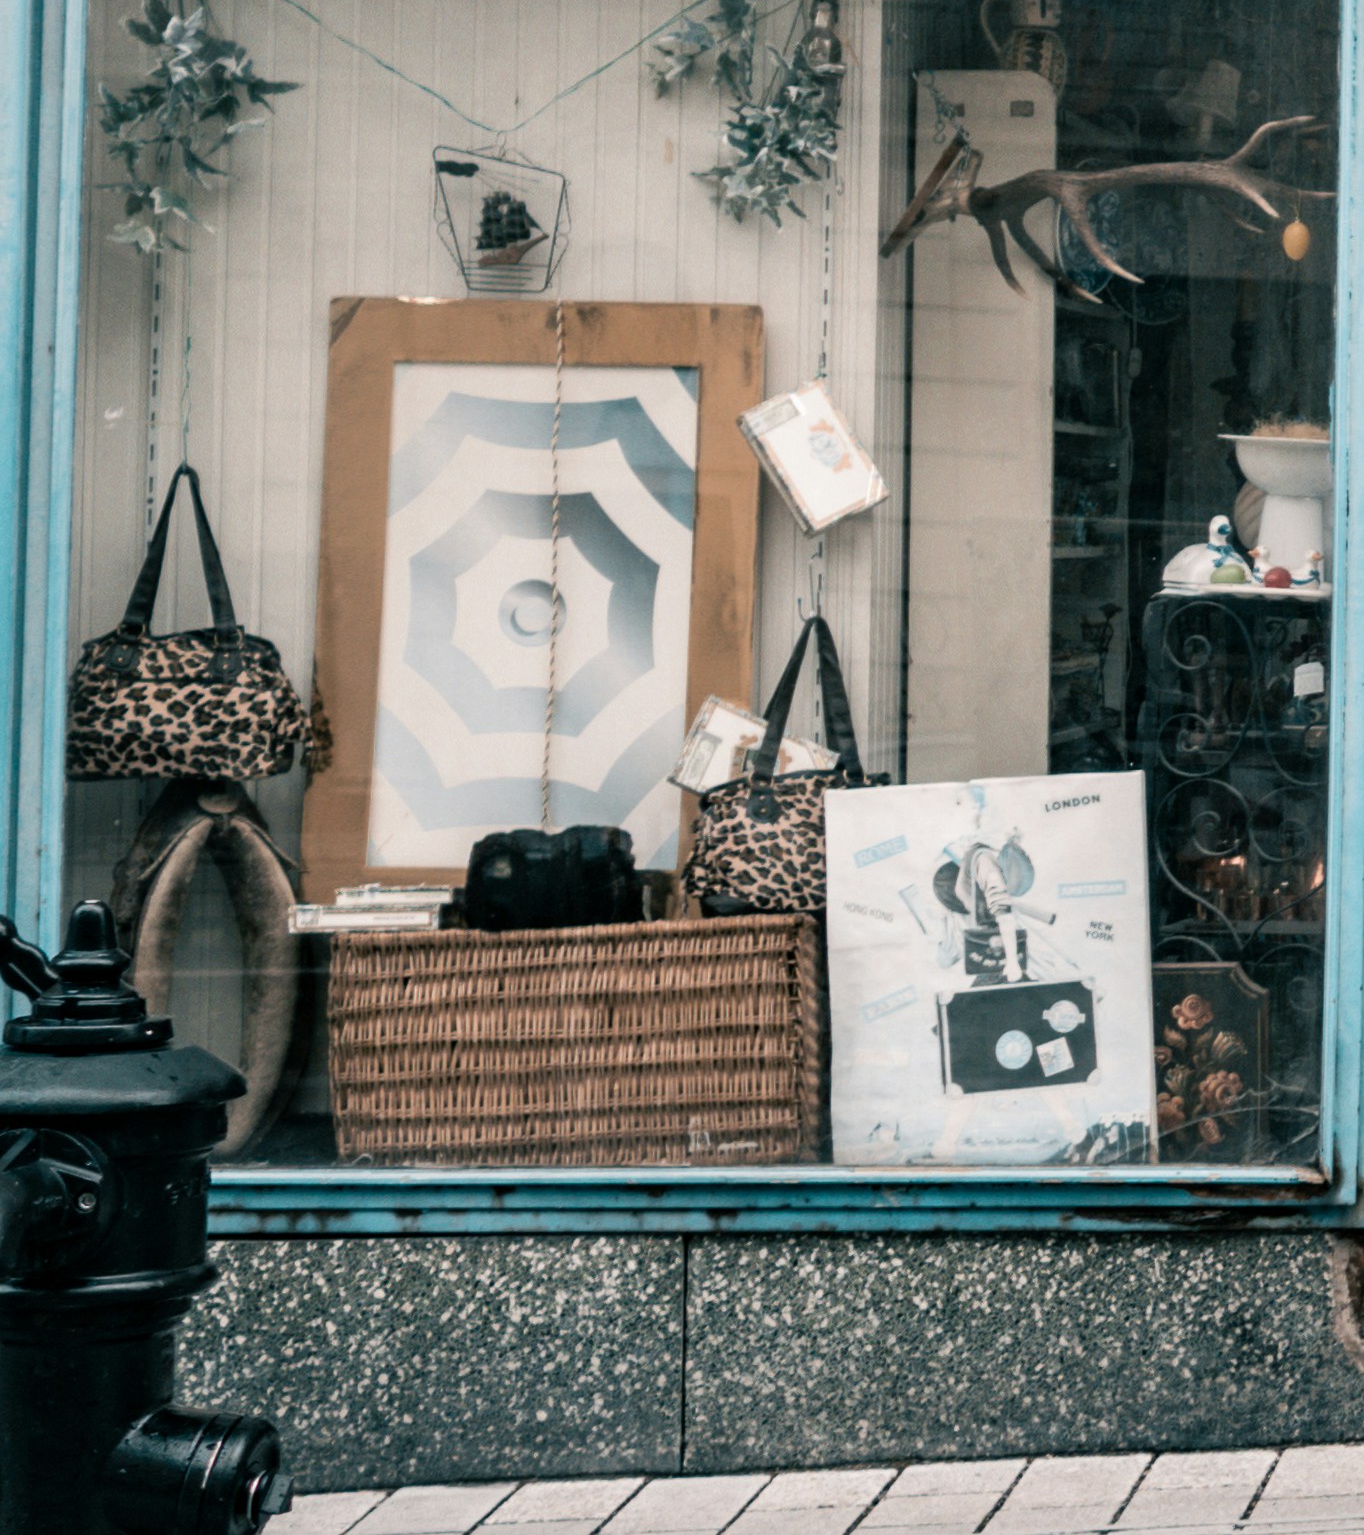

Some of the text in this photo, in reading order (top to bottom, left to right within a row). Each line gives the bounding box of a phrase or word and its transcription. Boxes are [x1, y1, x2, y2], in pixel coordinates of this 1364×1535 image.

[1044, 794, 1102, 813] LONDON
[856, 837, 906, 866] ROME
[1089, 921, 1114, 932] NEW
[1085, 930, 1115, 942] YORK
